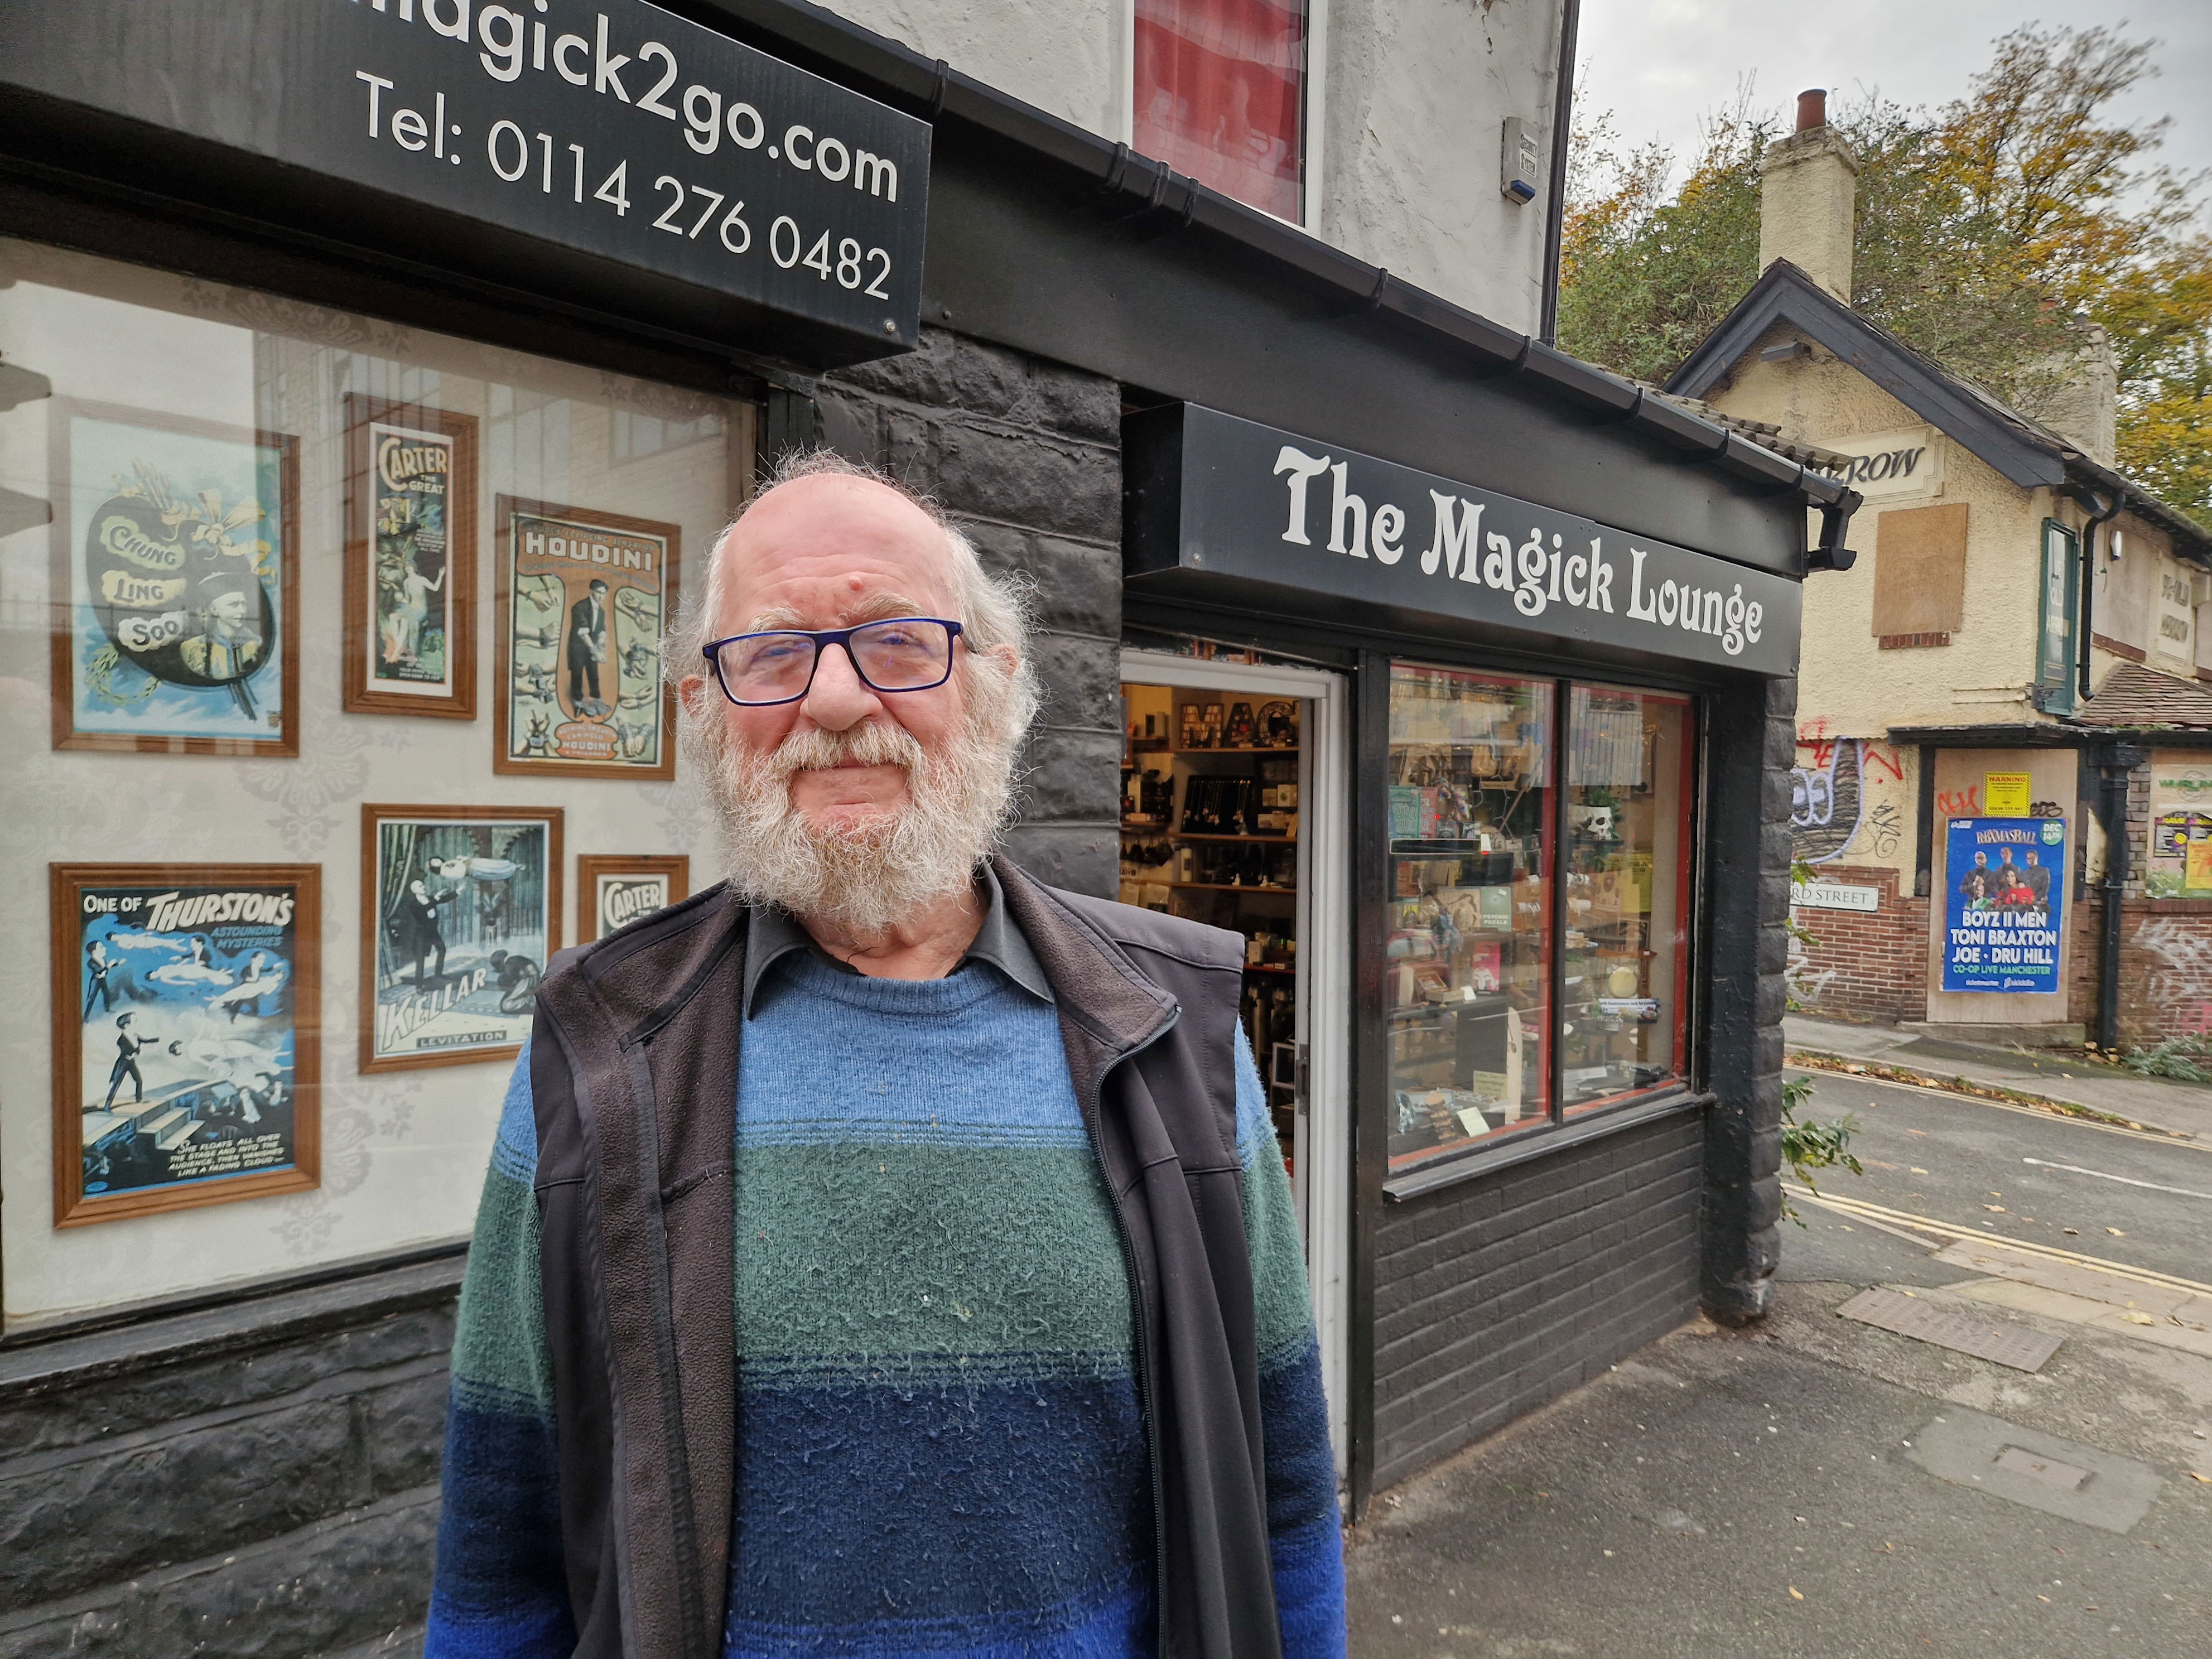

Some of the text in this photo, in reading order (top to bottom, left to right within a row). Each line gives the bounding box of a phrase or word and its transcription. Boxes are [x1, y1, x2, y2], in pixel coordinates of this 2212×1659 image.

[349, 0, 897, 203] agick2go.com
[1521, 134, 1537, 157] SECURITY
[1521, 153, 1535, 174] SYSTEM
[355, 70, 890, 301] Tel: 0114 276 0482
[379, 437, 447, 491] CARTER
[409, 481, 445, 494] GREAT
[109, 525, 176, 565] CHUNG
[526, 532, 652, 572] HOUDINI
[1273, 445, 1762, 655] The Magick Lounge
[114, 578, 164, 602] LING
[132, 620, 179, 646] SOO
[563, 741, 610, 751] HOUDINI
[2042, 832, 2062, 841] 14TH
[2043, 823, 2061, 832] DEC
[604, 882, 660, 929] CARTER
[1815, 889, 1869, 904] STREET
[83, 891, 296, 932] ONE OF THURSTON'S
[1963, 911, 2047, 928] BOYZ II MEN
[211, 925, 285, 938] ASTOUNDING
[1950, 929, 2057, 946] TONI BRAXTON
[216, 937, 283, 949] MYSTERIES
[1951, 947, 2054, 964] JOE DRU HILL
[1953, 964, 2051, 975] CO-OP LIVE MANCHESTER
[382, 967, 487, 1051] KELLAR
[420, 1031, 503, 1046] LEVITATION
[170, 1141, 279, 1163] THE STAGE AND INTO THE
[177, 1133, 281, 1154] SHE FLOATS ALL OVER
[218, 1154, 240, 1163] THEN
[243, 1147, 285, 1160] VANISHES
[177, 1167, 199, 1177] LIKE
[208, 1161, 241, 1171] FADING
